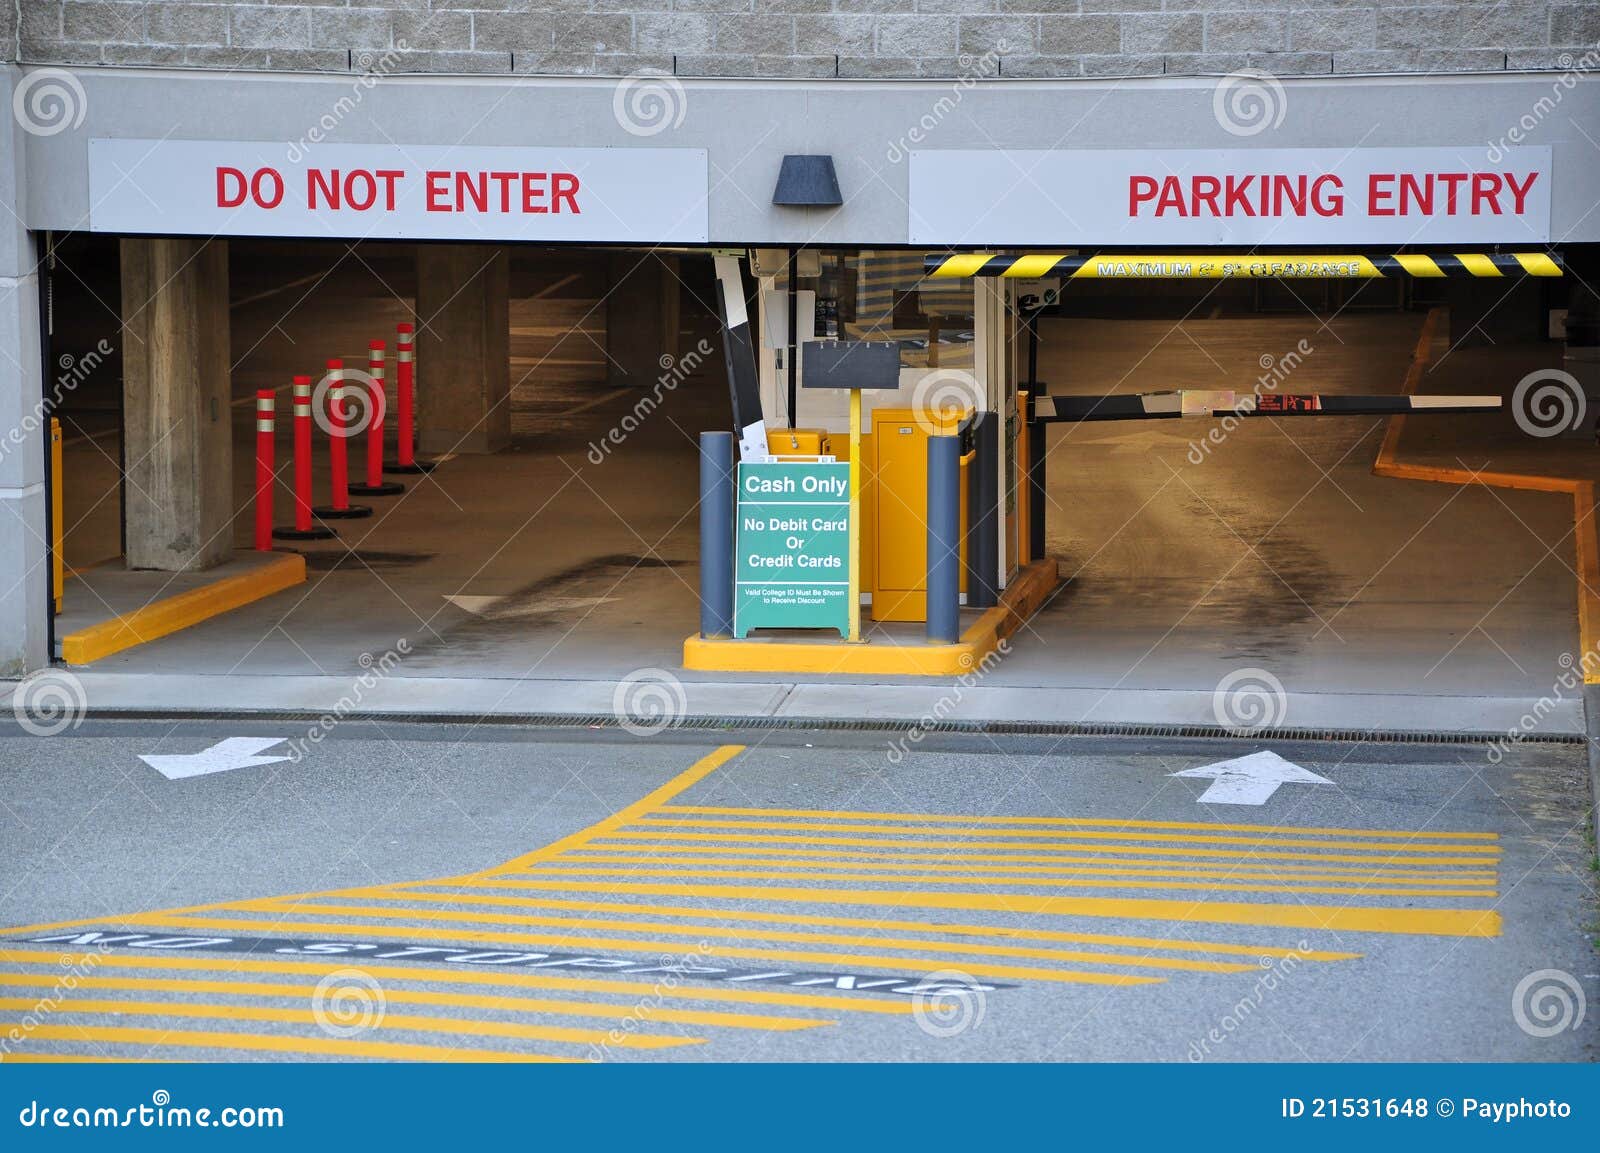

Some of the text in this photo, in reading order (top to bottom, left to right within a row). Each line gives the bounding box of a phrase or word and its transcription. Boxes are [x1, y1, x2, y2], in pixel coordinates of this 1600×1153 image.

[215, 166, 582, 214] DO NOT ENTER
[1128, 172, 1539, 218] PARKING ENTRY
[1097, 263, 1192, 277] MAXIMUM
[1250, 262, 1360, 277] CLEARANCE
[745, 476, 847, 497] Cash Only
[744, 518, 847, 532] No Debit Card
[786, 536, 805, 549] Or
[748, 554, 841, 568] Credit Cards
[762, 589, 786, 597] College
[29, 931, 233, 949] NO
